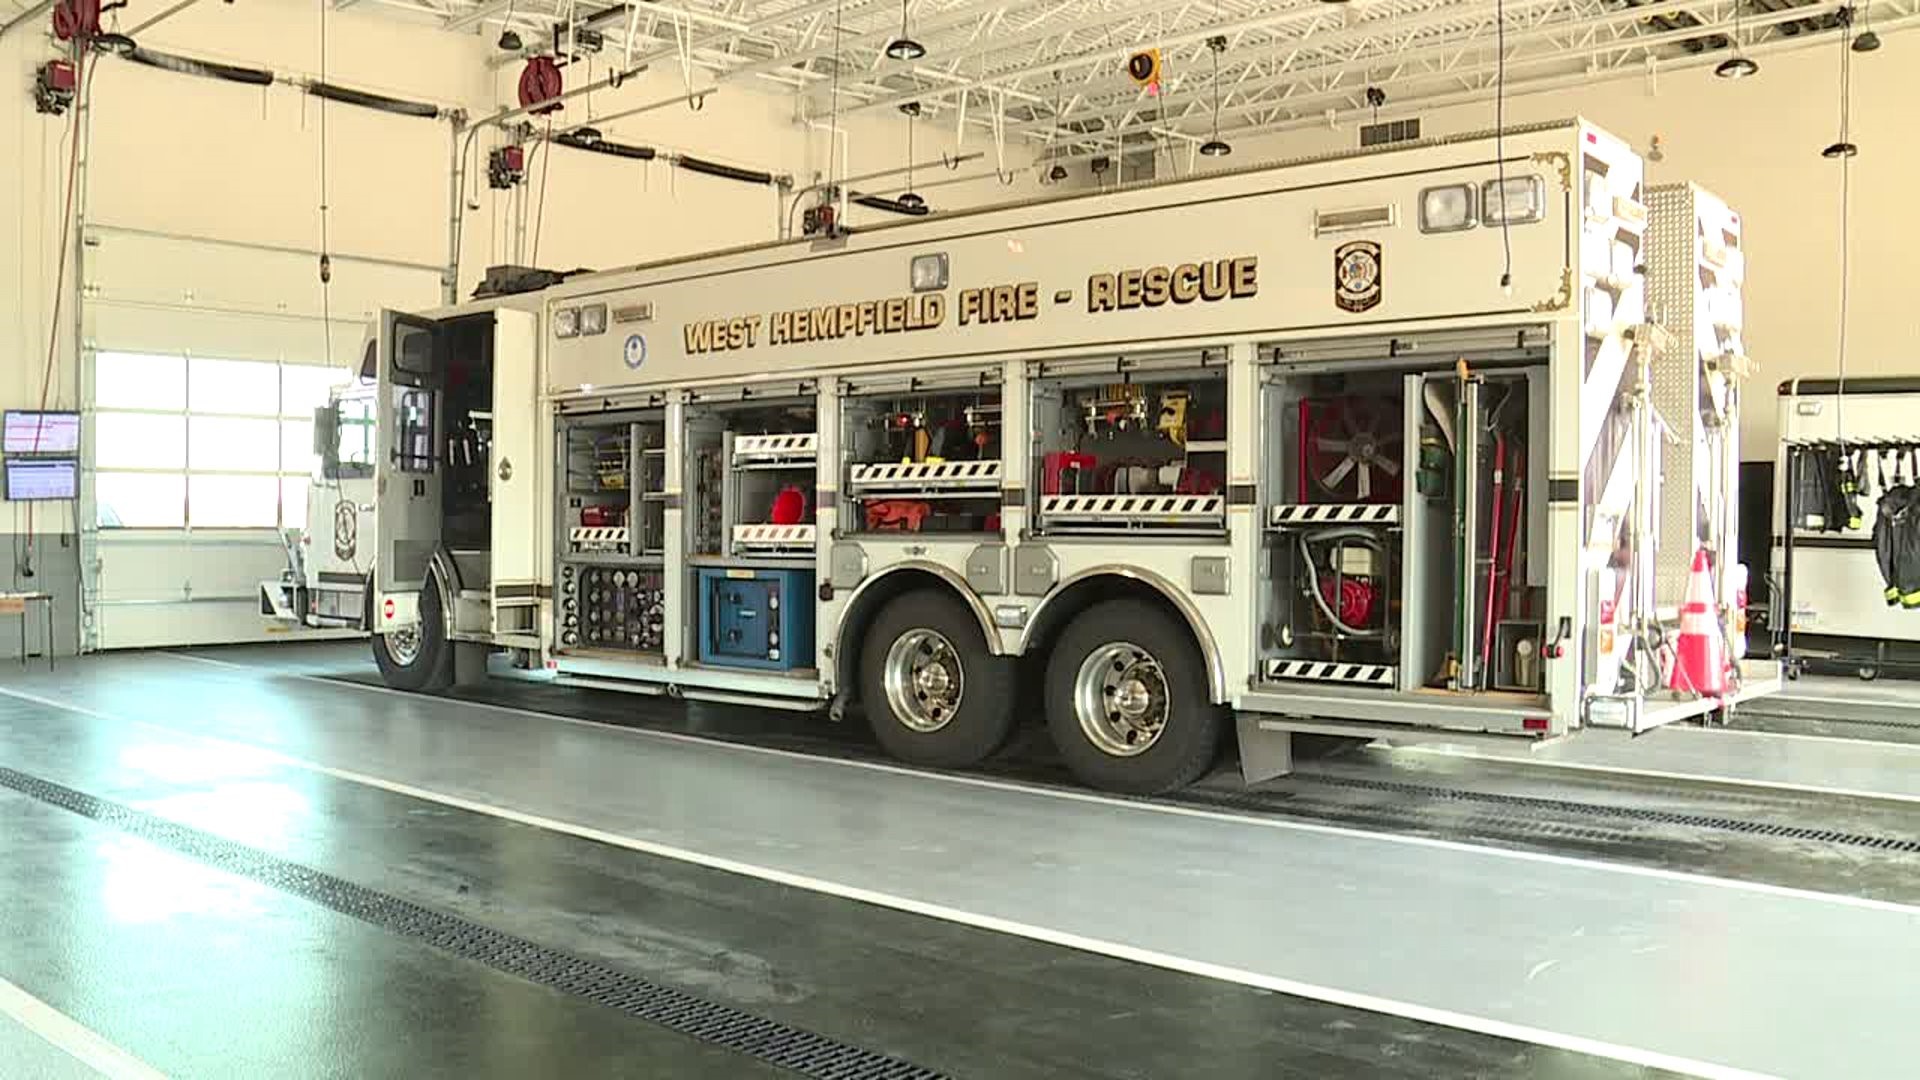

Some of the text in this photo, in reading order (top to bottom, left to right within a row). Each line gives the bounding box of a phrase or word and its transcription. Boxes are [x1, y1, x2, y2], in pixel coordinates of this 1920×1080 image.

[684, 256, 1258, 354] WEST HEMPFIELD FIRE - RESCUE
